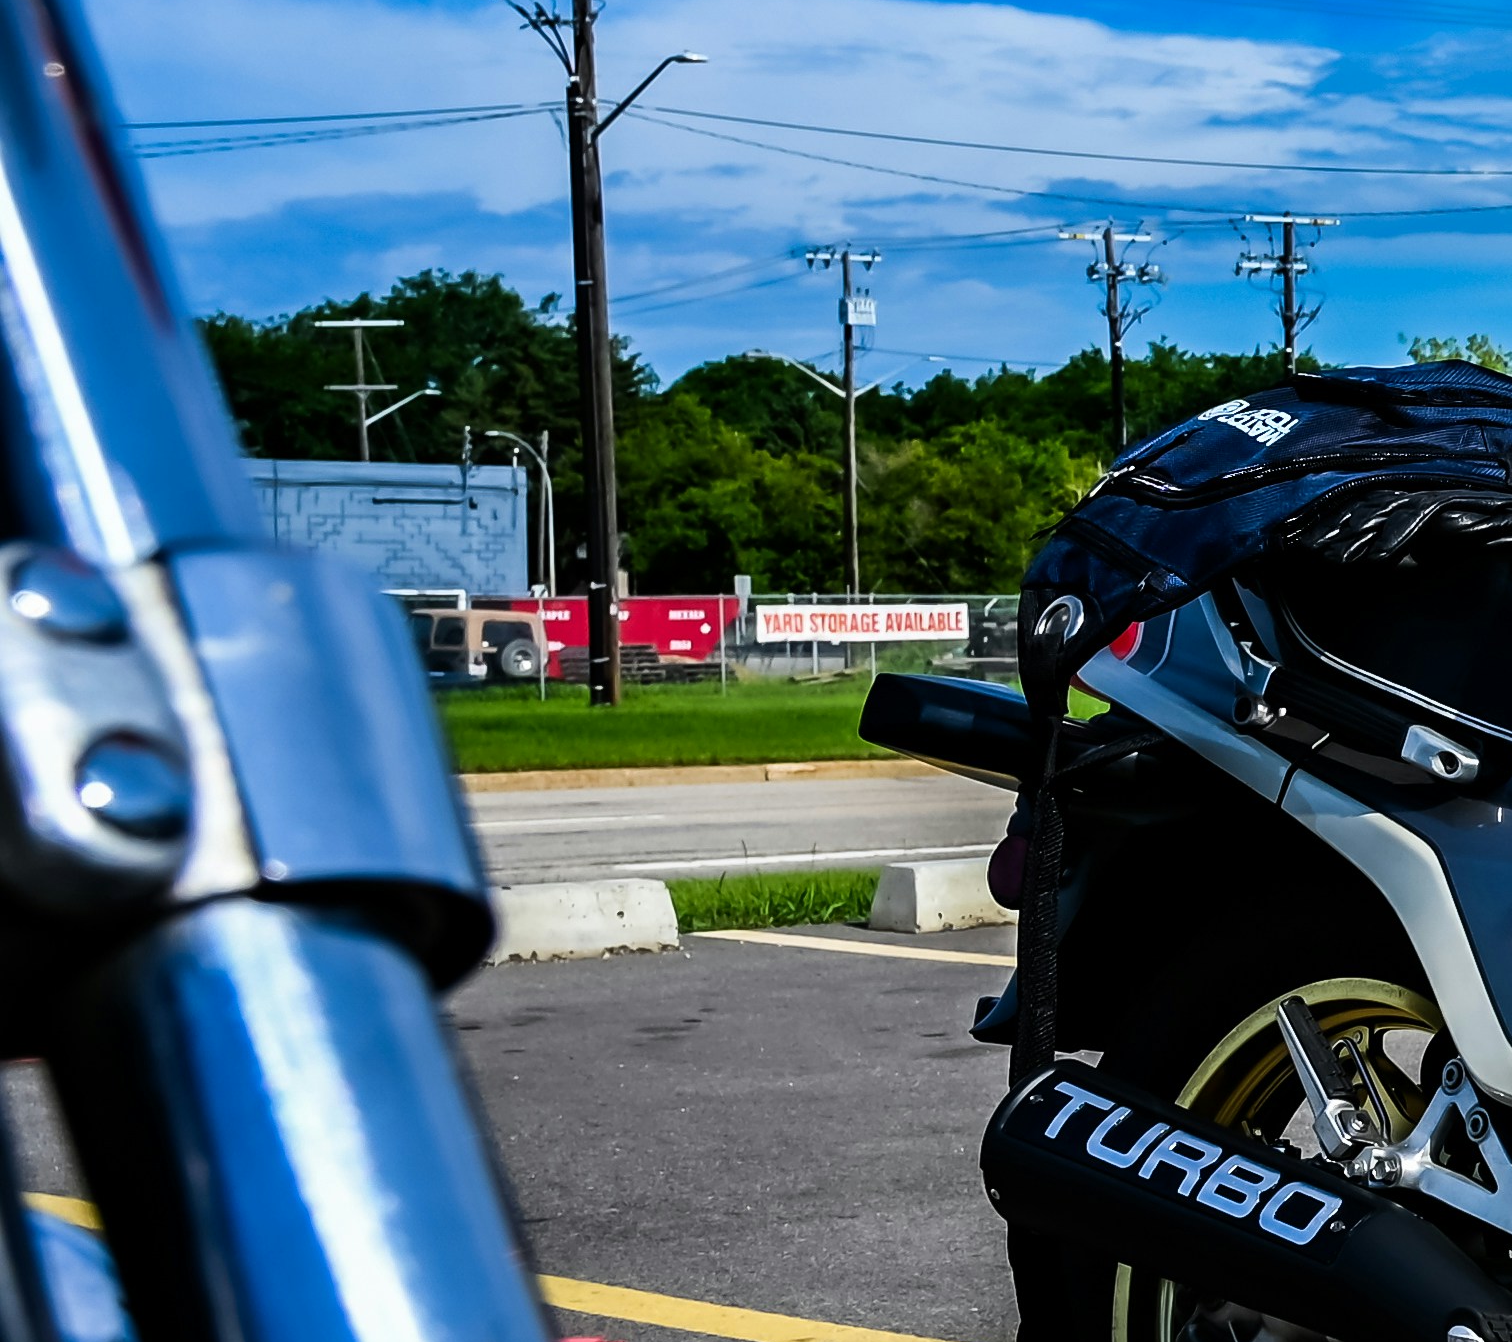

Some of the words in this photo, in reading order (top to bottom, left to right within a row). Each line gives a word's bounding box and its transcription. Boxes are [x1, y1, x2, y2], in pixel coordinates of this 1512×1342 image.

[763, 612, 804, 633] YARD
[809, 612, 880, 633] STORAGE
[885, 611, 963, 632] AVAILABLE
[1044, 1080, 1343, 1246] TURBO
